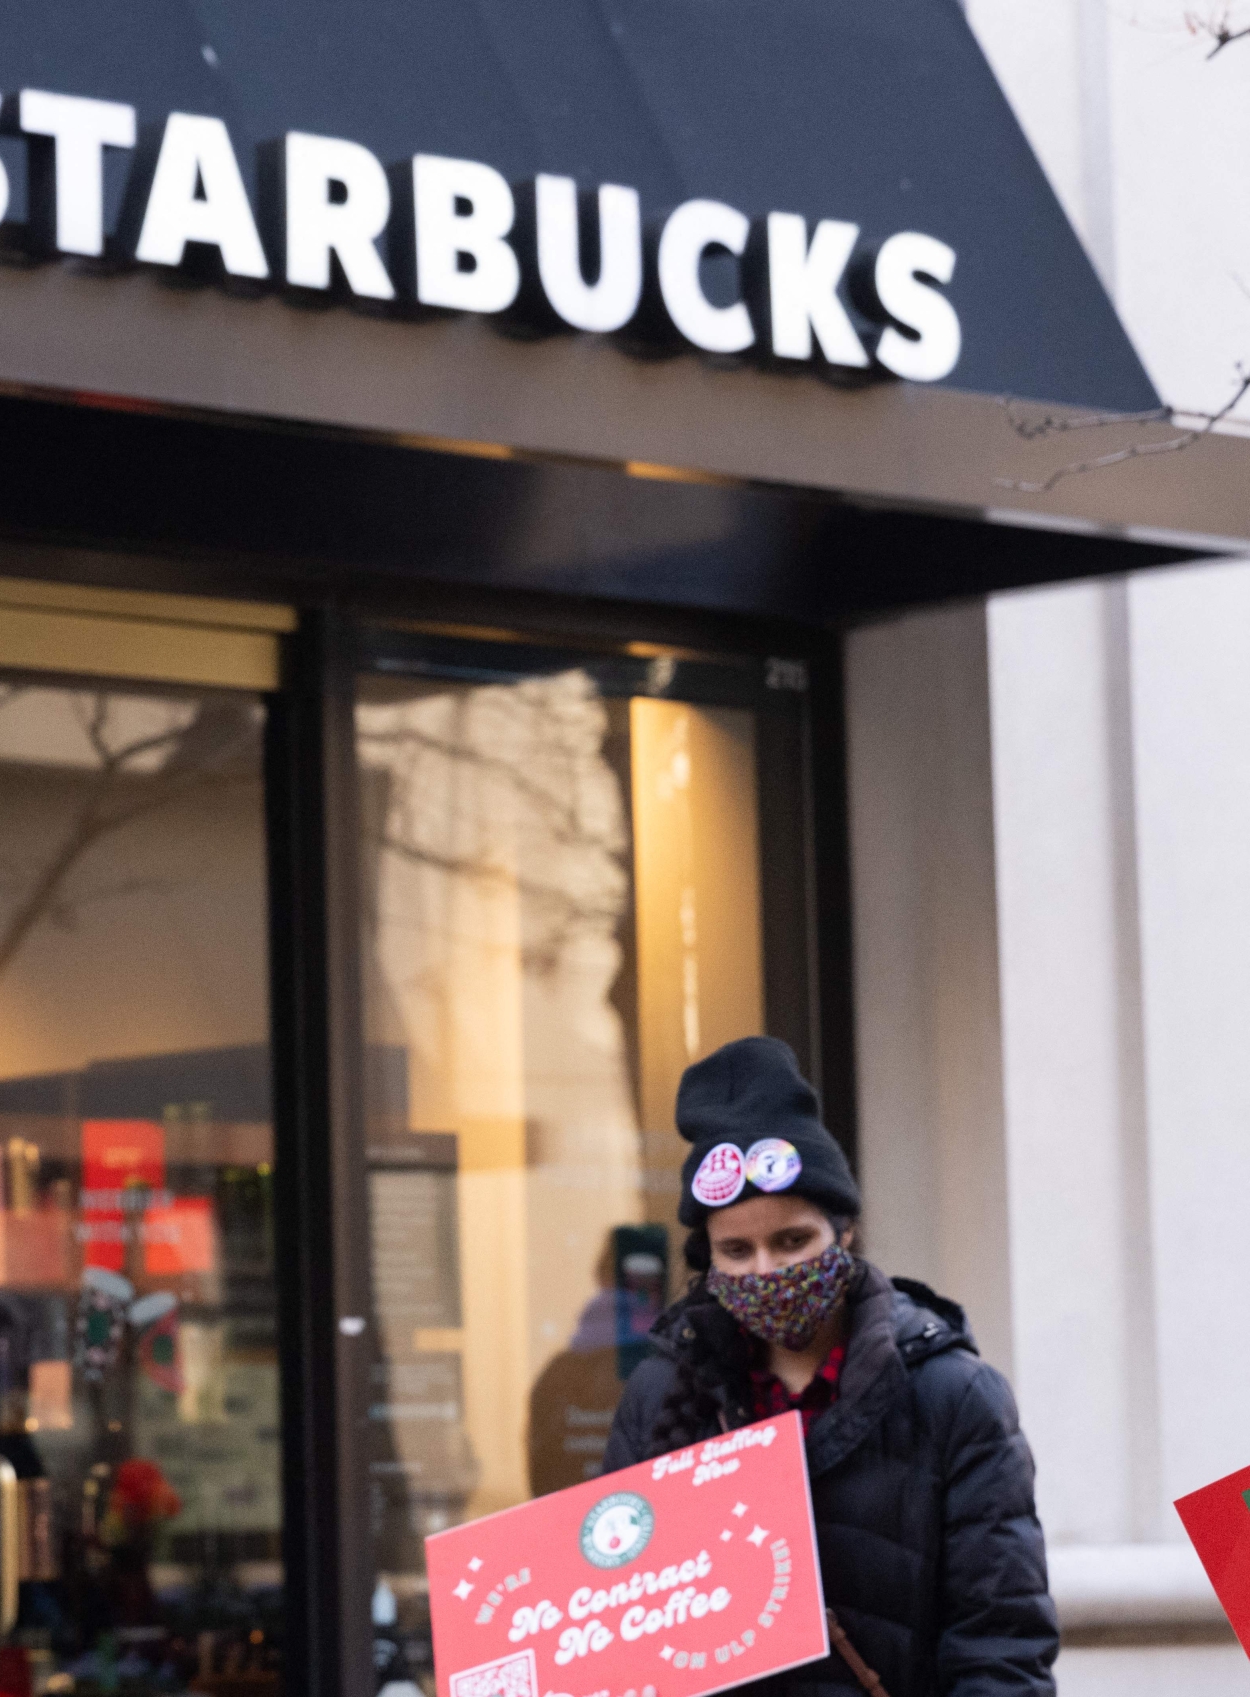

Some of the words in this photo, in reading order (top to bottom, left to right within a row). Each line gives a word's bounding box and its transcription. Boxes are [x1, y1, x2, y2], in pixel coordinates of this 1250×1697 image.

[651, 1450, 695, 1480] Full
[691, 1457, 741, 1487] Now
[508, 1600, 563, 1643] No
[568, 1550, 712, 1620] Contract
[554, 1619, 615, 1666] No
[619, 1586, 732, 1642] Coffee
[673, 1650, 706, 1670] ON
[714, 1629, 756, 1665] ULP
